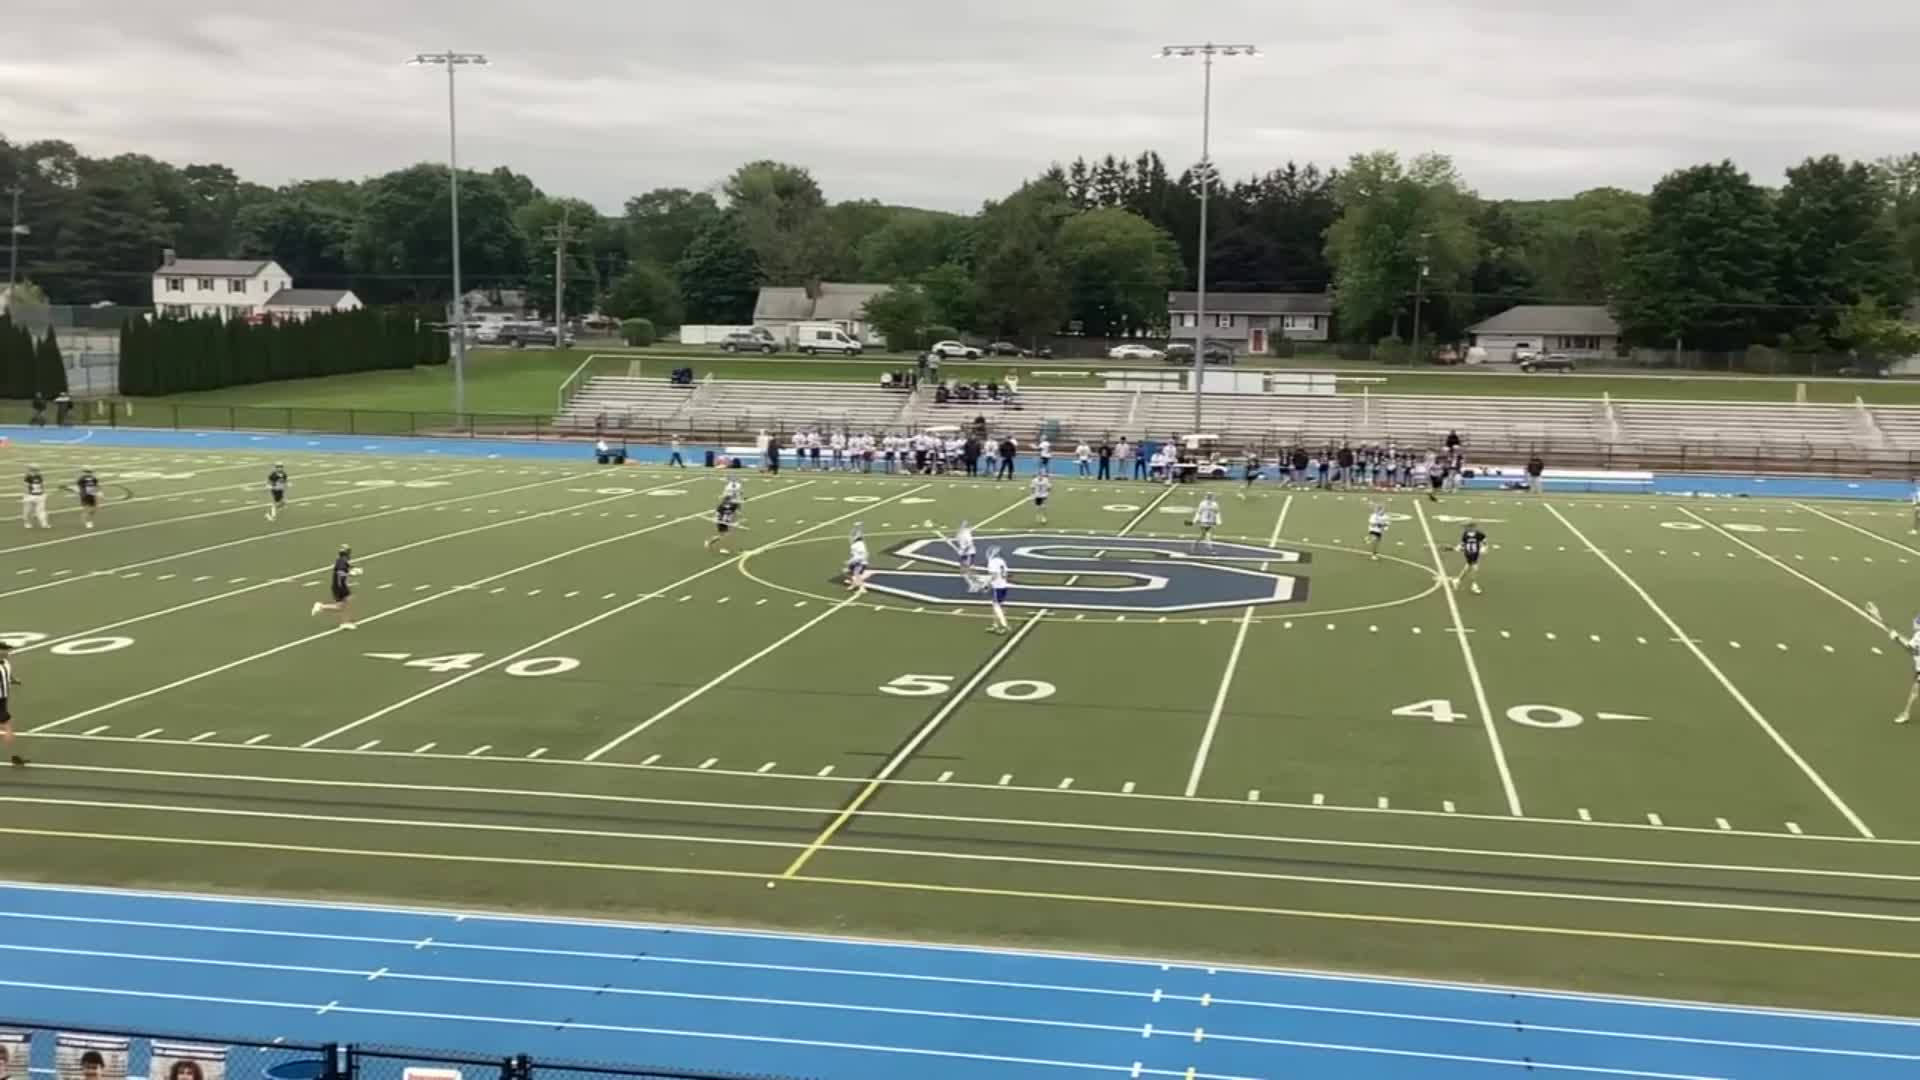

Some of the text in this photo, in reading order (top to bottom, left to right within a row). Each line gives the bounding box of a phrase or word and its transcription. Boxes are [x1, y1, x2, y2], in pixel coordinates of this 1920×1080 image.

[404, 653, 581, 677] 40
[878, 674, 1057, 699] 50
[1391, 699, 1584, 728] 40
